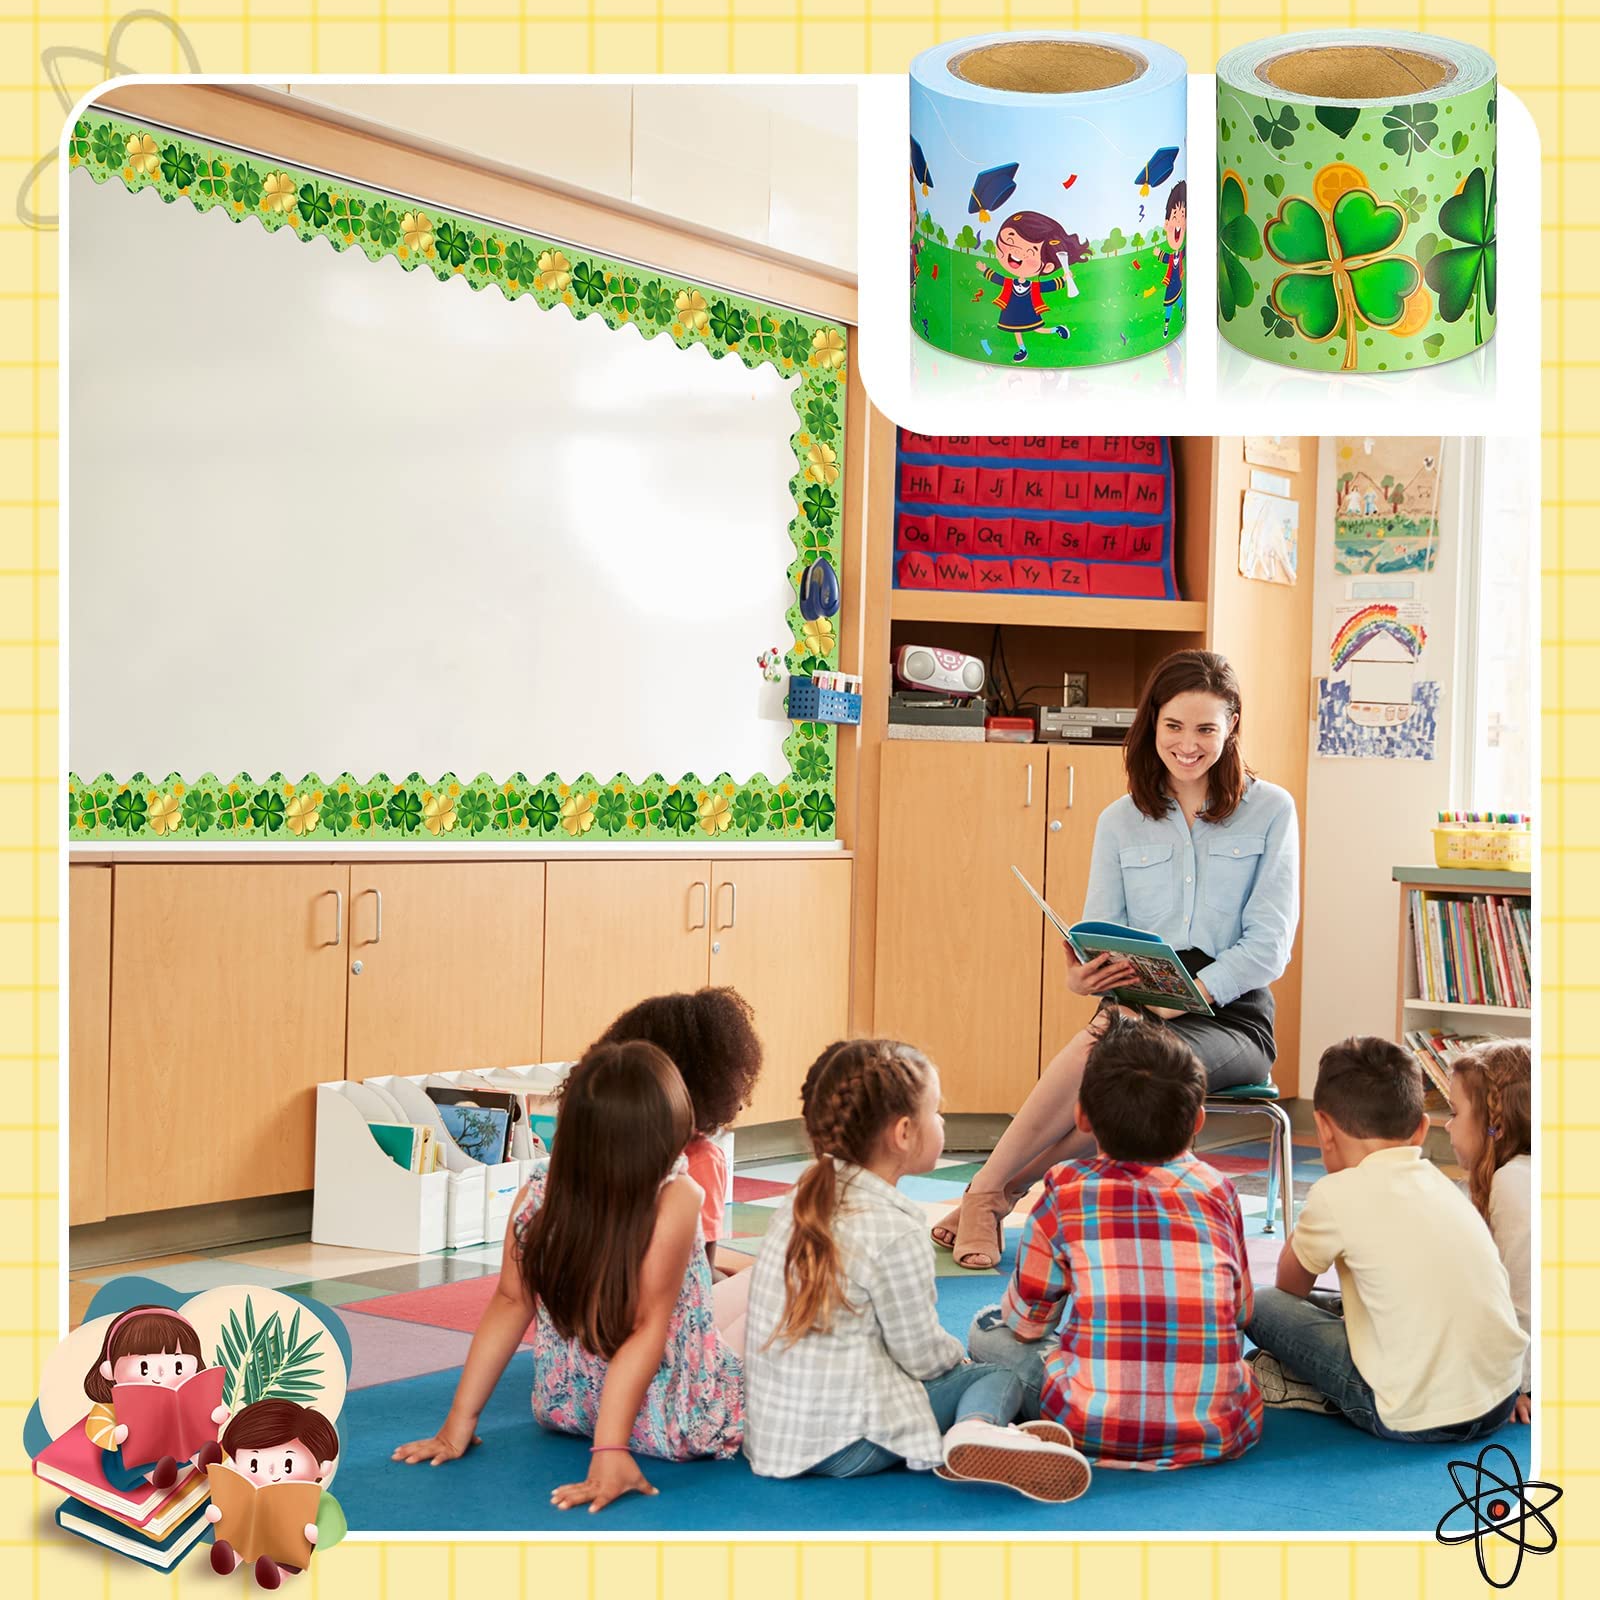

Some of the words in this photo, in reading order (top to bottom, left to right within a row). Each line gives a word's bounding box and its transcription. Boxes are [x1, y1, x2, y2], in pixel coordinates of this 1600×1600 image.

[988, 436, 1009, 446] Cc
[1024, 436, 1046, 448] Dd
[1061, 436, 1079, 449] Ee
[1103, 436, 1119, 451] Ff
[1131, 436, 1155, 456] Gg
[910, 477, 932, 493] Hh
[952, 478, 965, 494] Ii
[989, 478, 1004, 498] Jj
[1025, 481, 1043, 497] Kk
[1065, 483, 1079, 499] Ll
[1094, 484, 1122, 499] Mm
[1136, 485, 1157, 501] Nn
[904, 526, 929, 542] Oo
[946, 526, 966, 546] Pp
[978, 527, 1004, 548] Qq
[1024, 531, 1042, 546] Rr
[1061, 532, 1079, 548] Ss
[1102, 536, 1117, 550] Tt
[1133, 537, 1152, 552] Uu
[908, 562, 927, 578] Vv
[939, 564, 969, 580] Ww
[980, 569, 1002, 582] Xx
[1021, 566, 1040, 583] Yy
[1061, 569, 1080, 584] Zz
